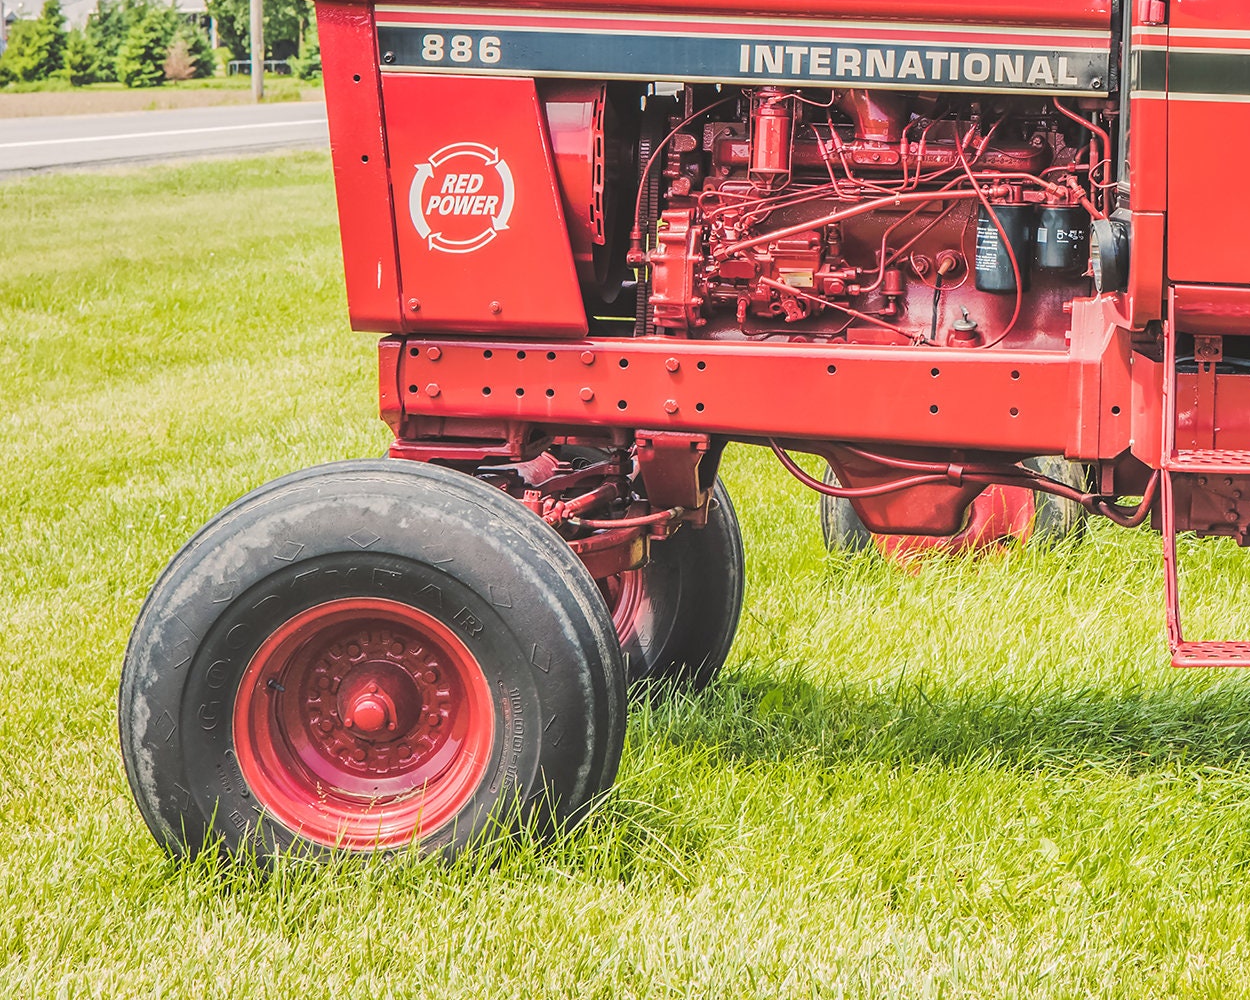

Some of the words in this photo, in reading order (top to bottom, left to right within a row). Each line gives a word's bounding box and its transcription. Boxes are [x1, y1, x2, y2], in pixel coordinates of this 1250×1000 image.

[422, 34, 501, 63] 886
[739, 44, 1078, 85] INTERNATIONAL
[441, 174, 484, 194] RED
[425, 195, 499, 215] POWER
